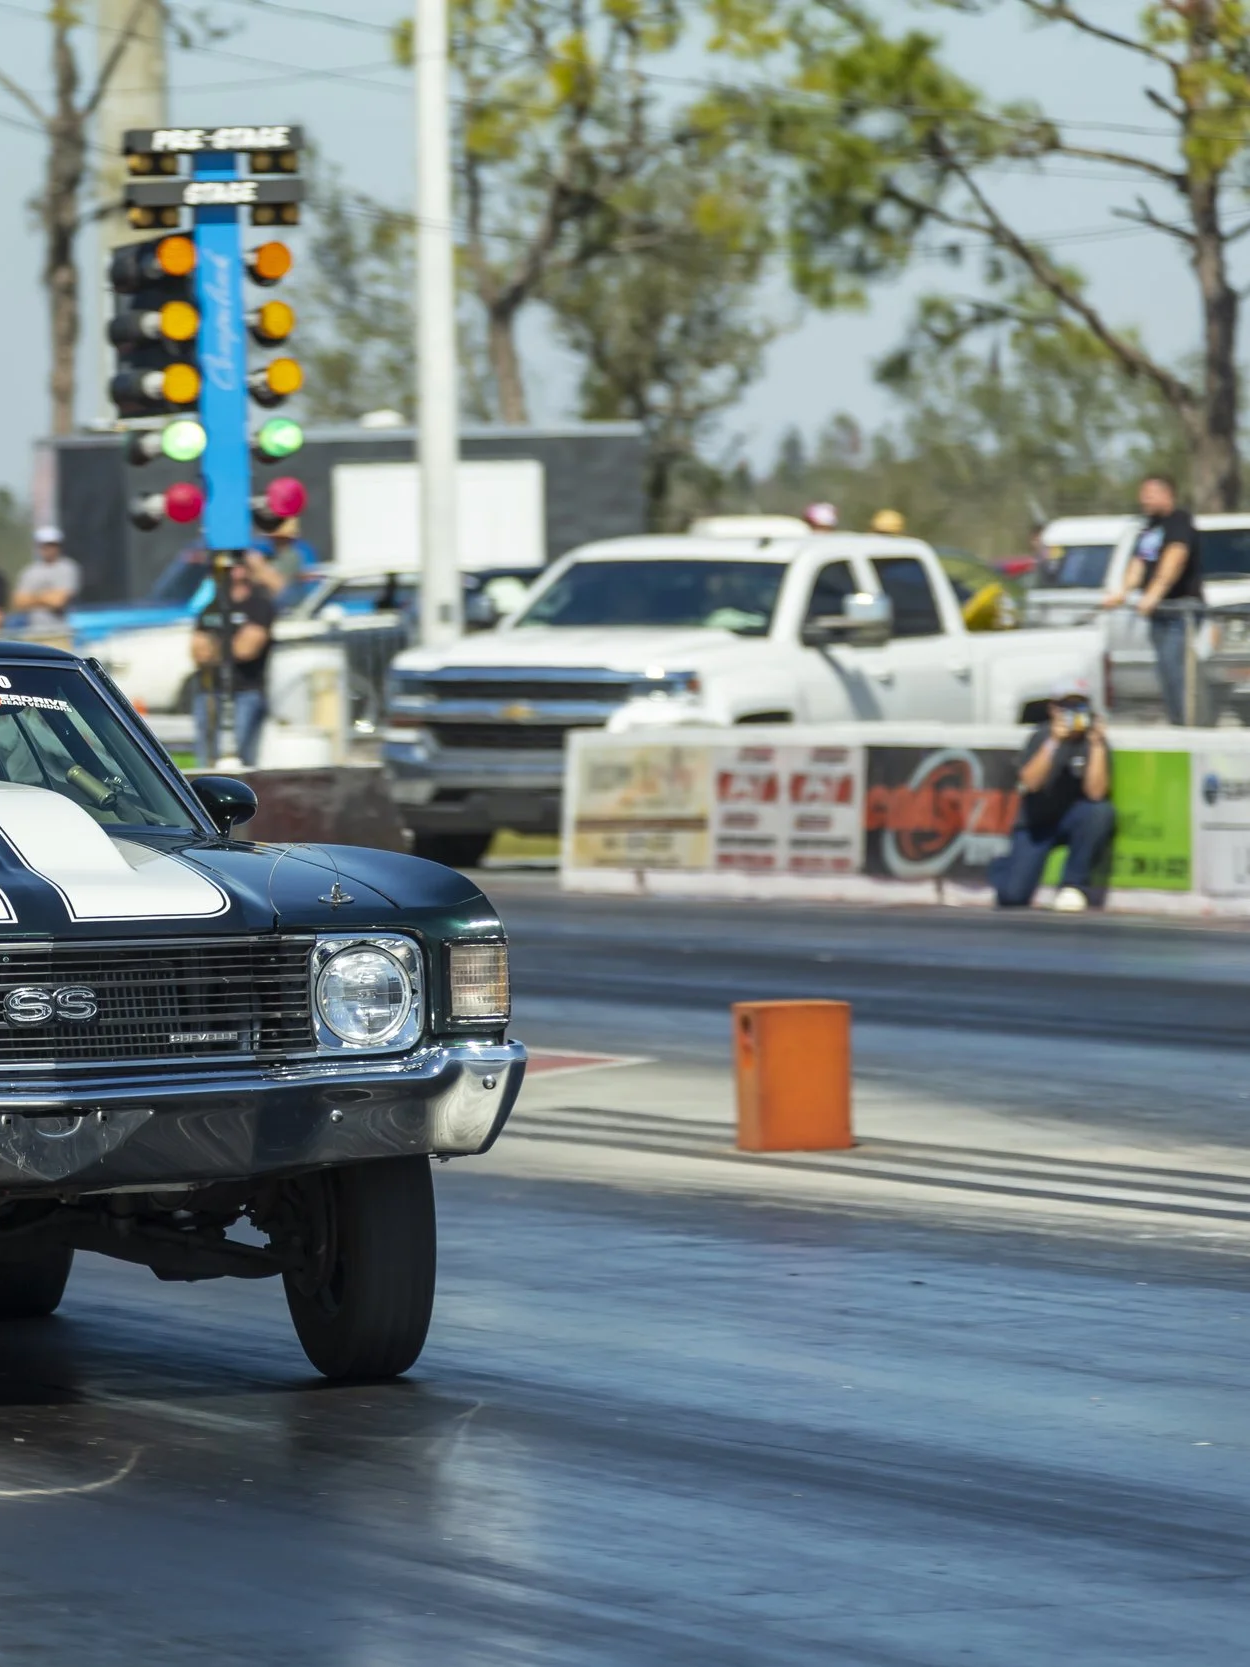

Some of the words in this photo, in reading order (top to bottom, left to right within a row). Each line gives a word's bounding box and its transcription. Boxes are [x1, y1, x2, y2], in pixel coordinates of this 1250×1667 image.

[183, 182, 258, 204] STAGE
[28, 701, 73, 713] VENDORS
[3, 986, 99, 1027] SS
